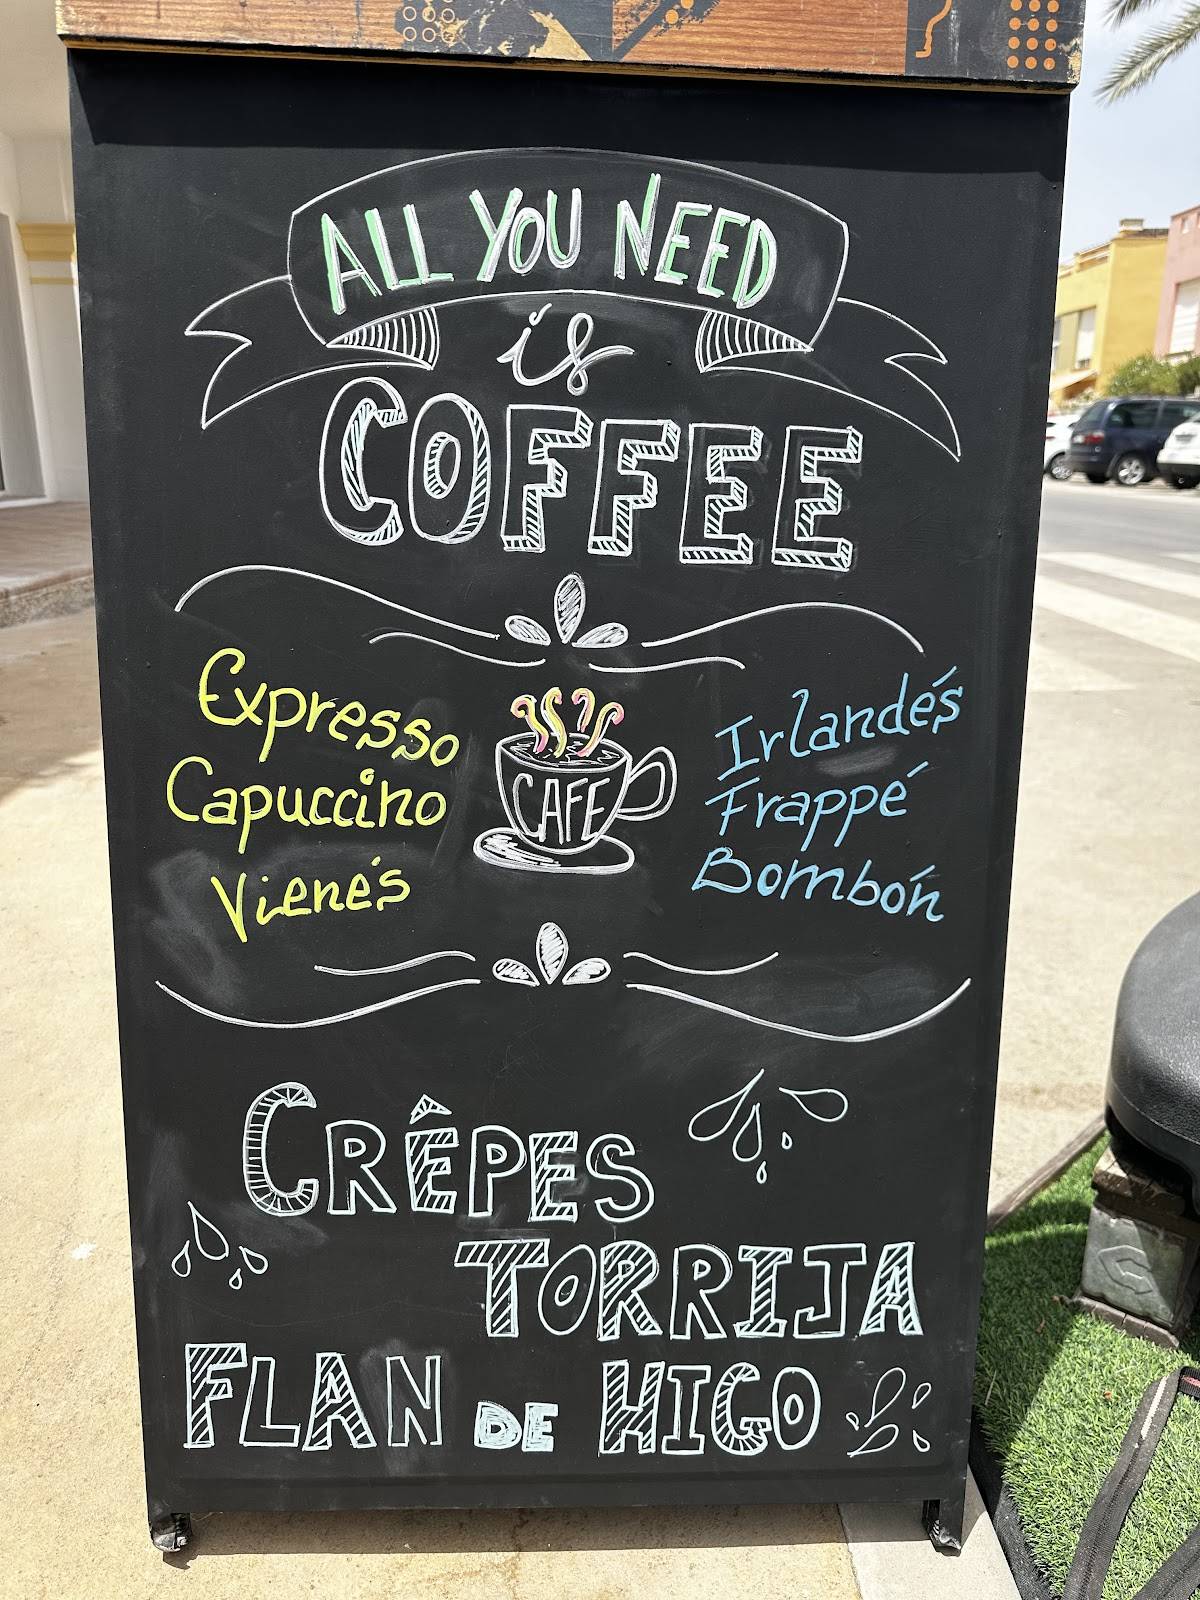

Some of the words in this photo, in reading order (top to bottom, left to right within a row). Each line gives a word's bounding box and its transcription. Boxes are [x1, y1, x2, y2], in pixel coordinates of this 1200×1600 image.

[322, 204, 453, 314] ALL
[469, 187, 582, 282] YOU
[614, 173, 777, 309] NEED
[497, 304, 635, 396] is
[318, 377, 864, 572] COFFEE
[198, 648, 460, 767] Expresso
[714, 666, 964, 779] Irlandés
[165, 756, 448, 853] Capuccino
[511, 771, 611, 842] CAFE
[706, 761, 928, 849] Frappé
[211, 855, 411, 942] Vienés
[692, 847, 943, 923] Bombón
[243, 1081, 656, 1223] CRÊPES
[454, 1239, 924, 1340] TORRIJA
[184, 1342, 443, 1451] FLAN
[474, 1401, 559, 1453] DE
[598, 1359, 822, 1457] HIGO
